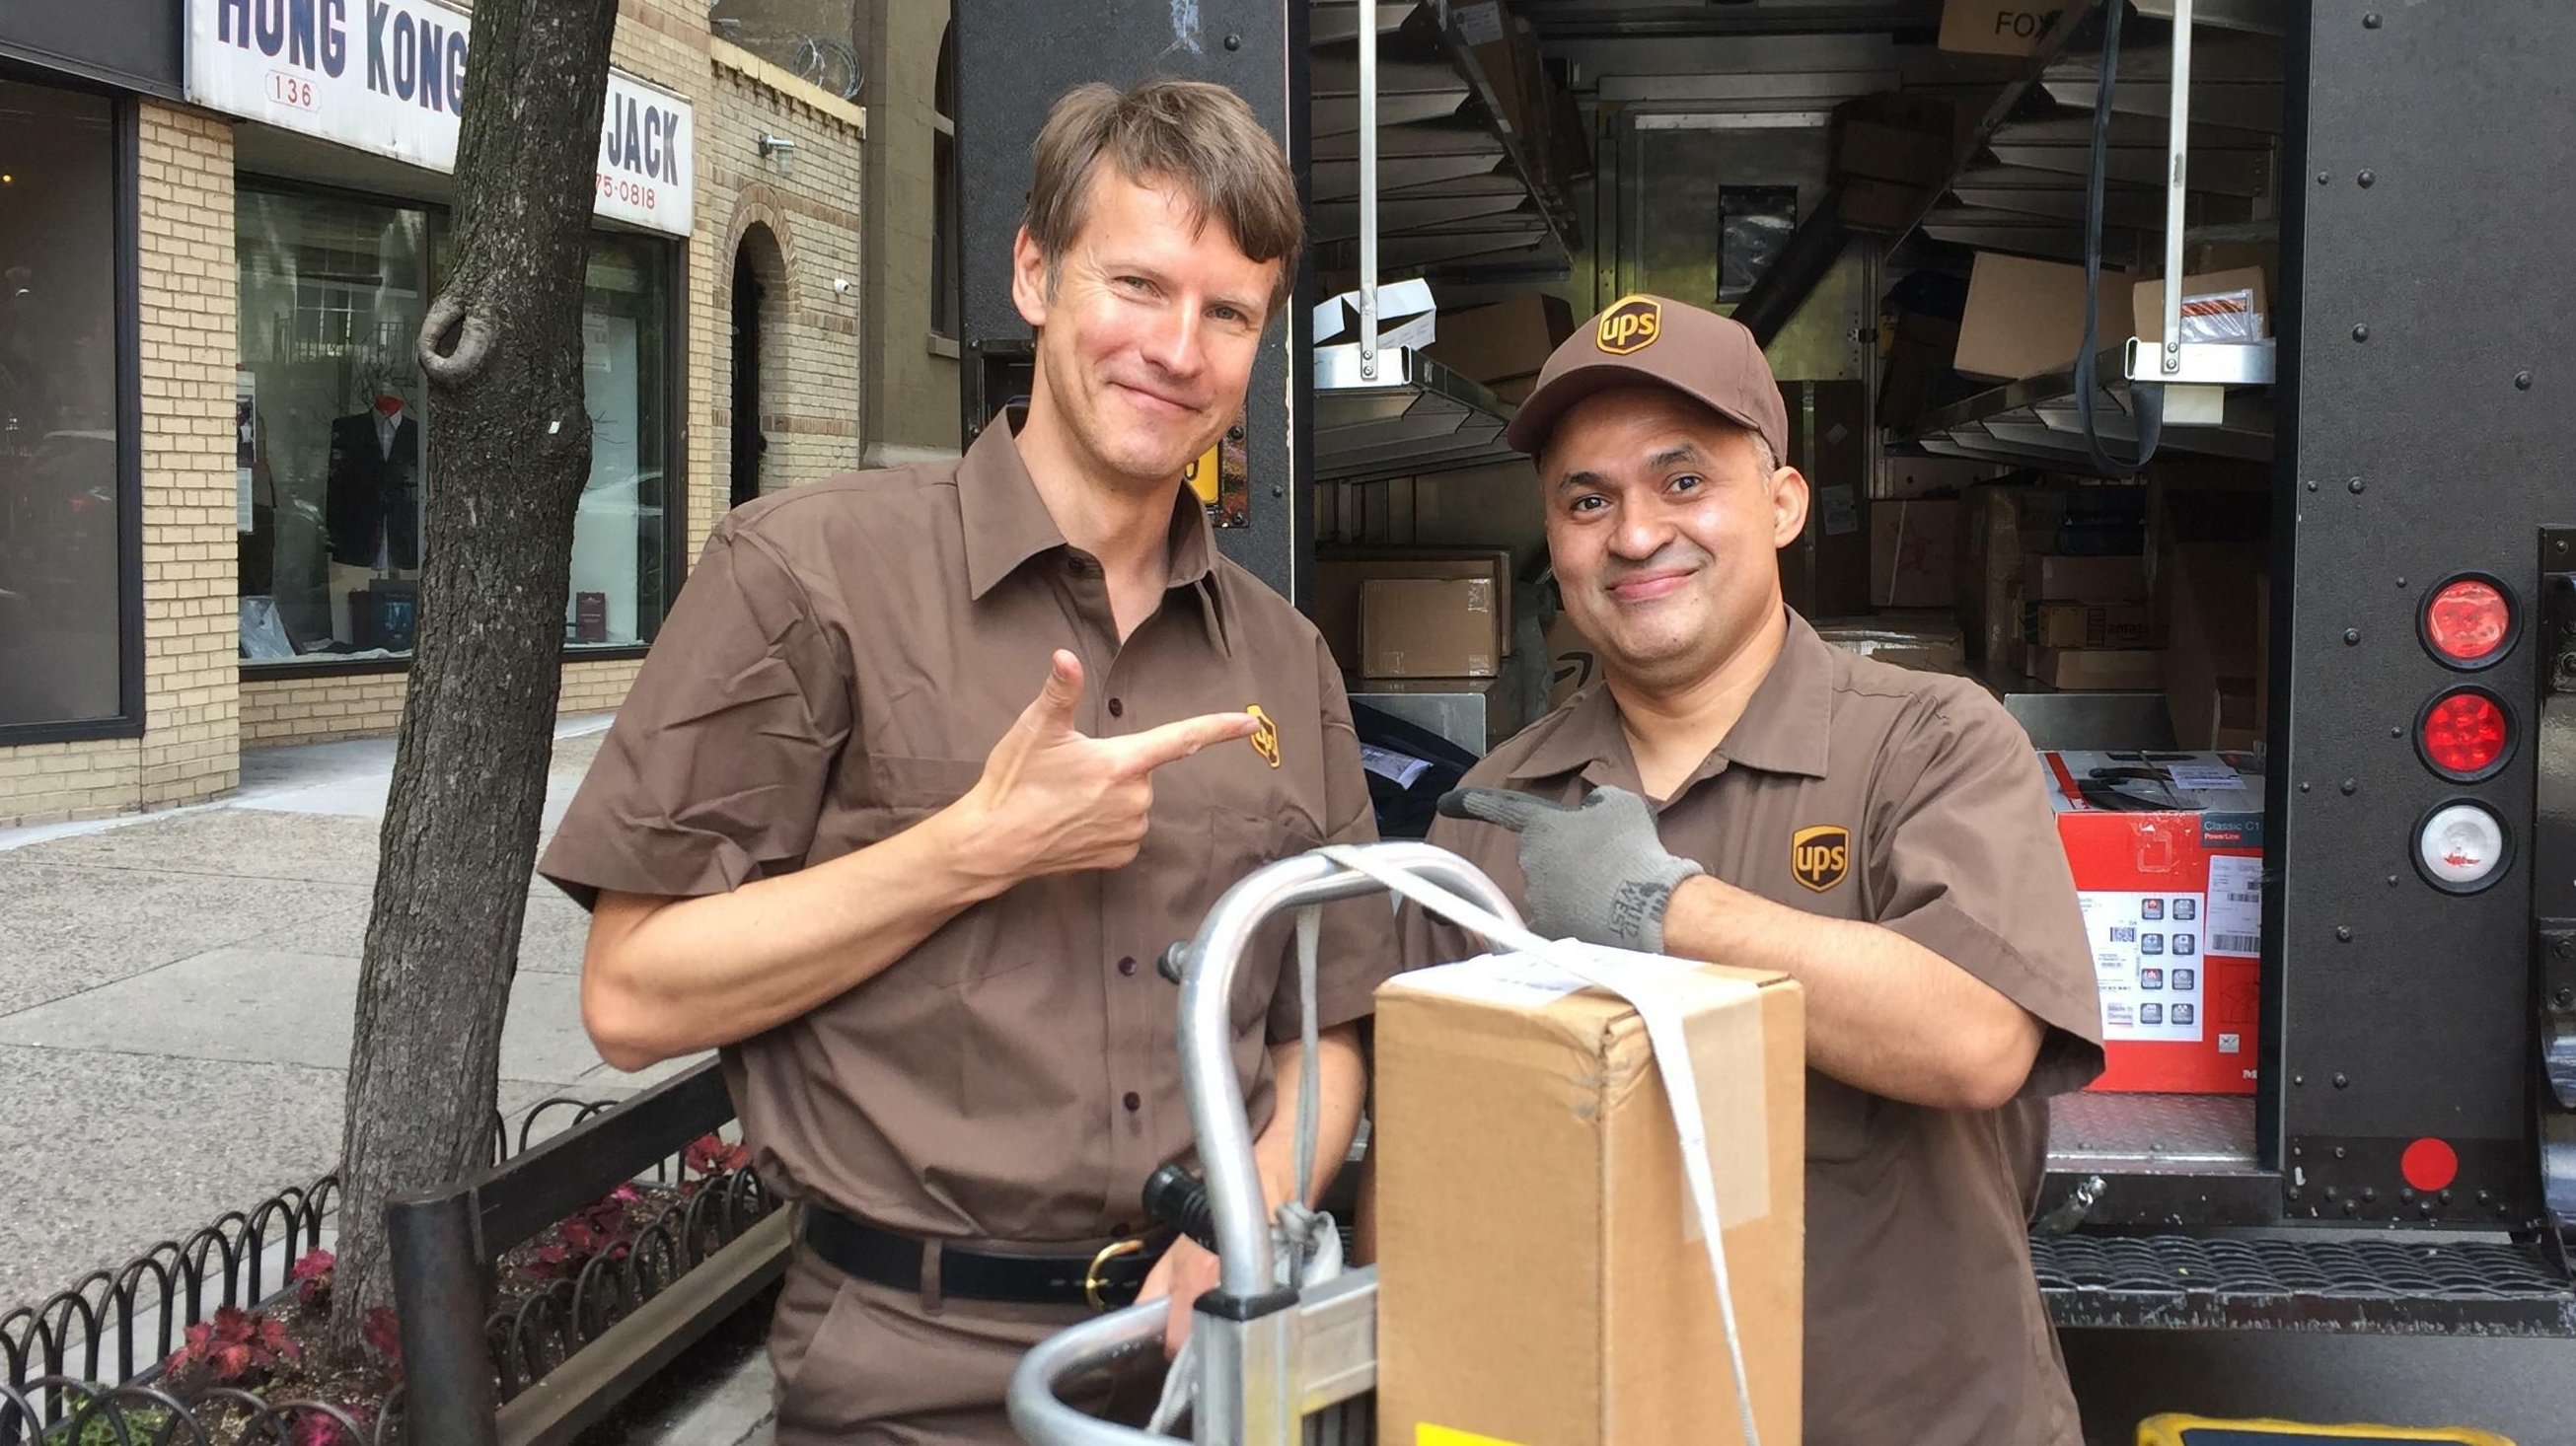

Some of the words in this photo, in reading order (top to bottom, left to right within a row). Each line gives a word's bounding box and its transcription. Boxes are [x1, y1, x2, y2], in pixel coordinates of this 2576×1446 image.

[275, 75, 311, 107] 136
[367, 0, 469, 117] KONG
[608, 92, 679, 186] JACK
[1602, 313, 1656, 346] ups
[1797, 845, 1844, 881] ups
